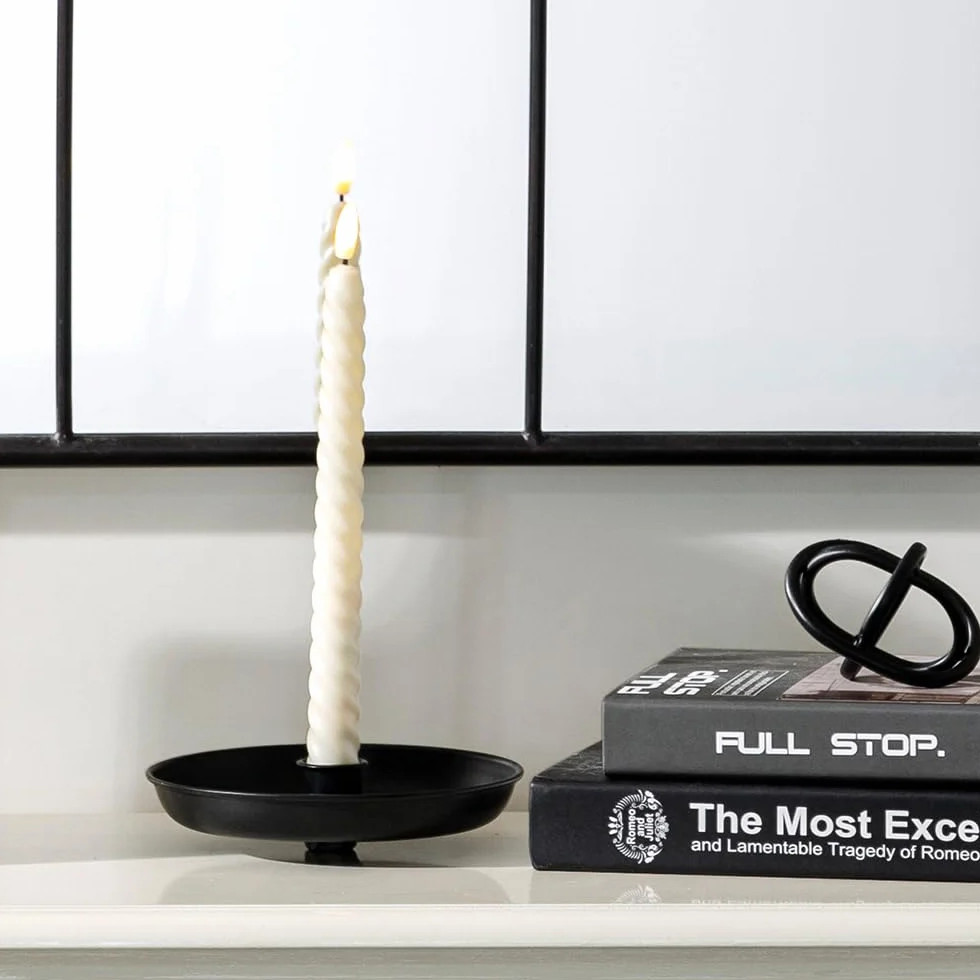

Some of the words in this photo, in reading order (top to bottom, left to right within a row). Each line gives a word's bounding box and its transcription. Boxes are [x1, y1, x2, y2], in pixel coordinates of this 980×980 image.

[617, 672, 677, 694] FULL
[715, 731, 810, 755] FULL
[831, 732, 945, 758] STOP.
[626, 808, 636, 845] Romeo
[636, 817, 645, 837] and
[644, 813, 654, 842] Juliet
[689, 803, 763, 835] The
[776, 806, 873, 839] Most
[885, 810, 980, 843] Exce
[691, 838, 722, 852] and
[727, 839, 823, 856] Lamentable
[828, 842, 895, 862] Tragedy
[900, 845, 917, 859] of
[921, 845, 980, 861] Romeo
